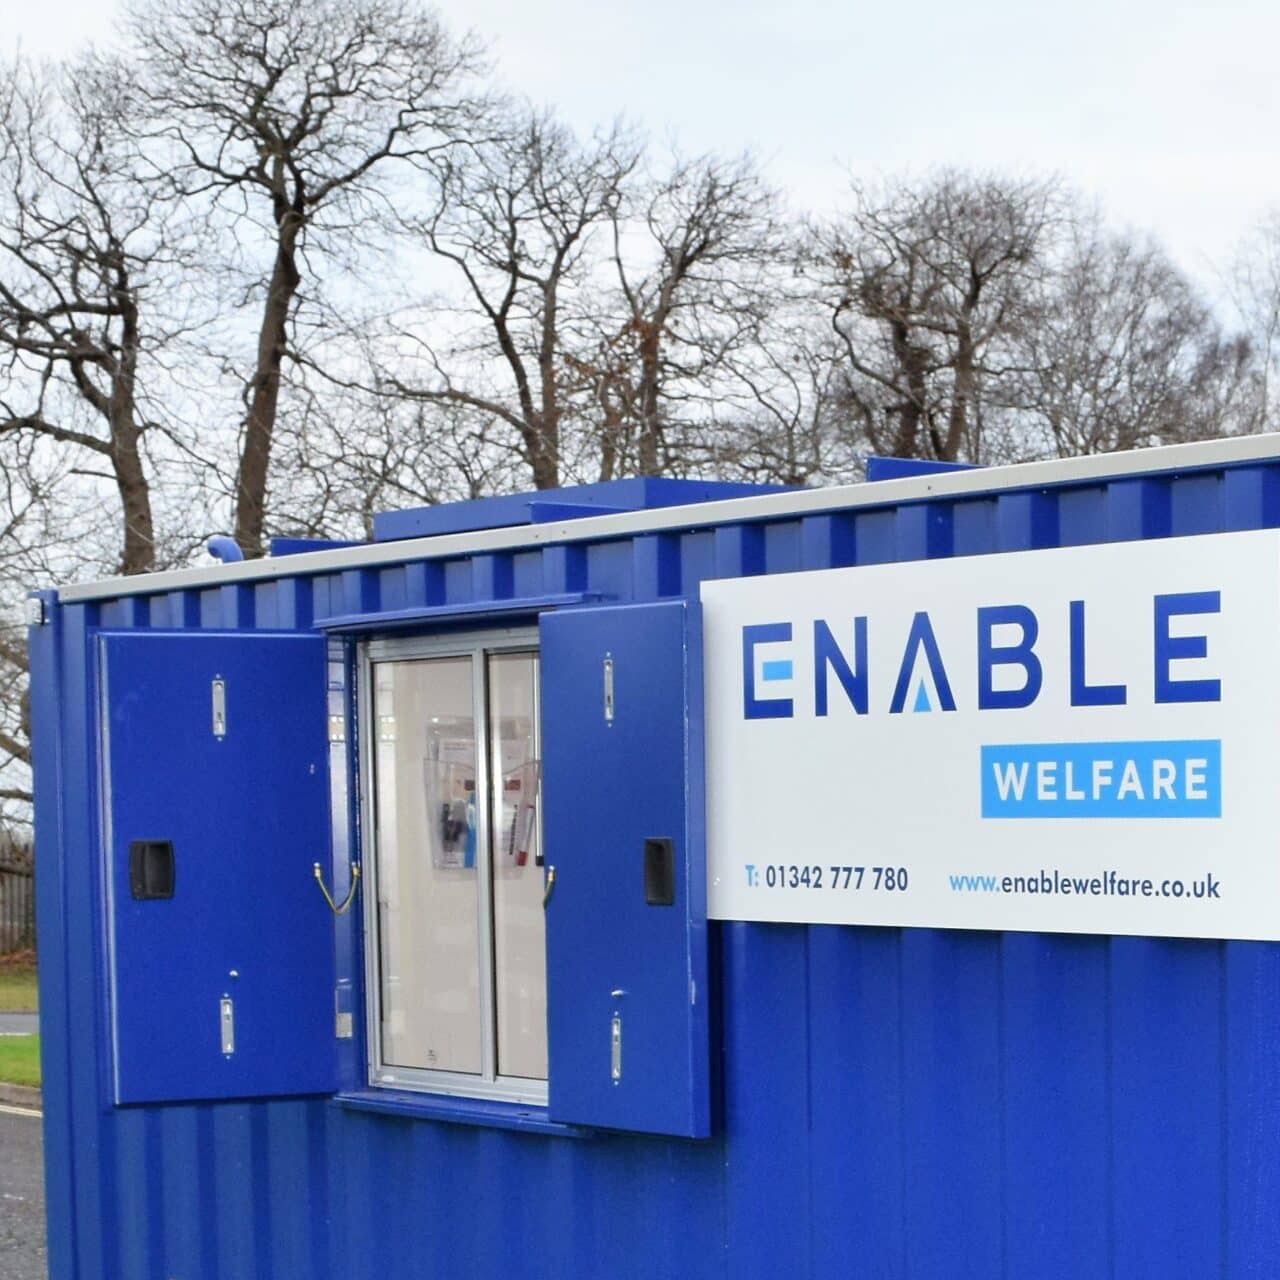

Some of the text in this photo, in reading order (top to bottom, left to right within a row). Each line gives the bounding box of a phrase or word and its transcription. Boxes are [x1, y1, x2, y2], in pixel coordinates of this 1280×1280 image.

[742, 591, 1222, 720] ENABLE
[992, 758, 1209, 801] WELFARE
[745, 864, 908, 891] T: 01342 777 780
[949, 869, 1221, 898] www.enablewelfare.co.uk
